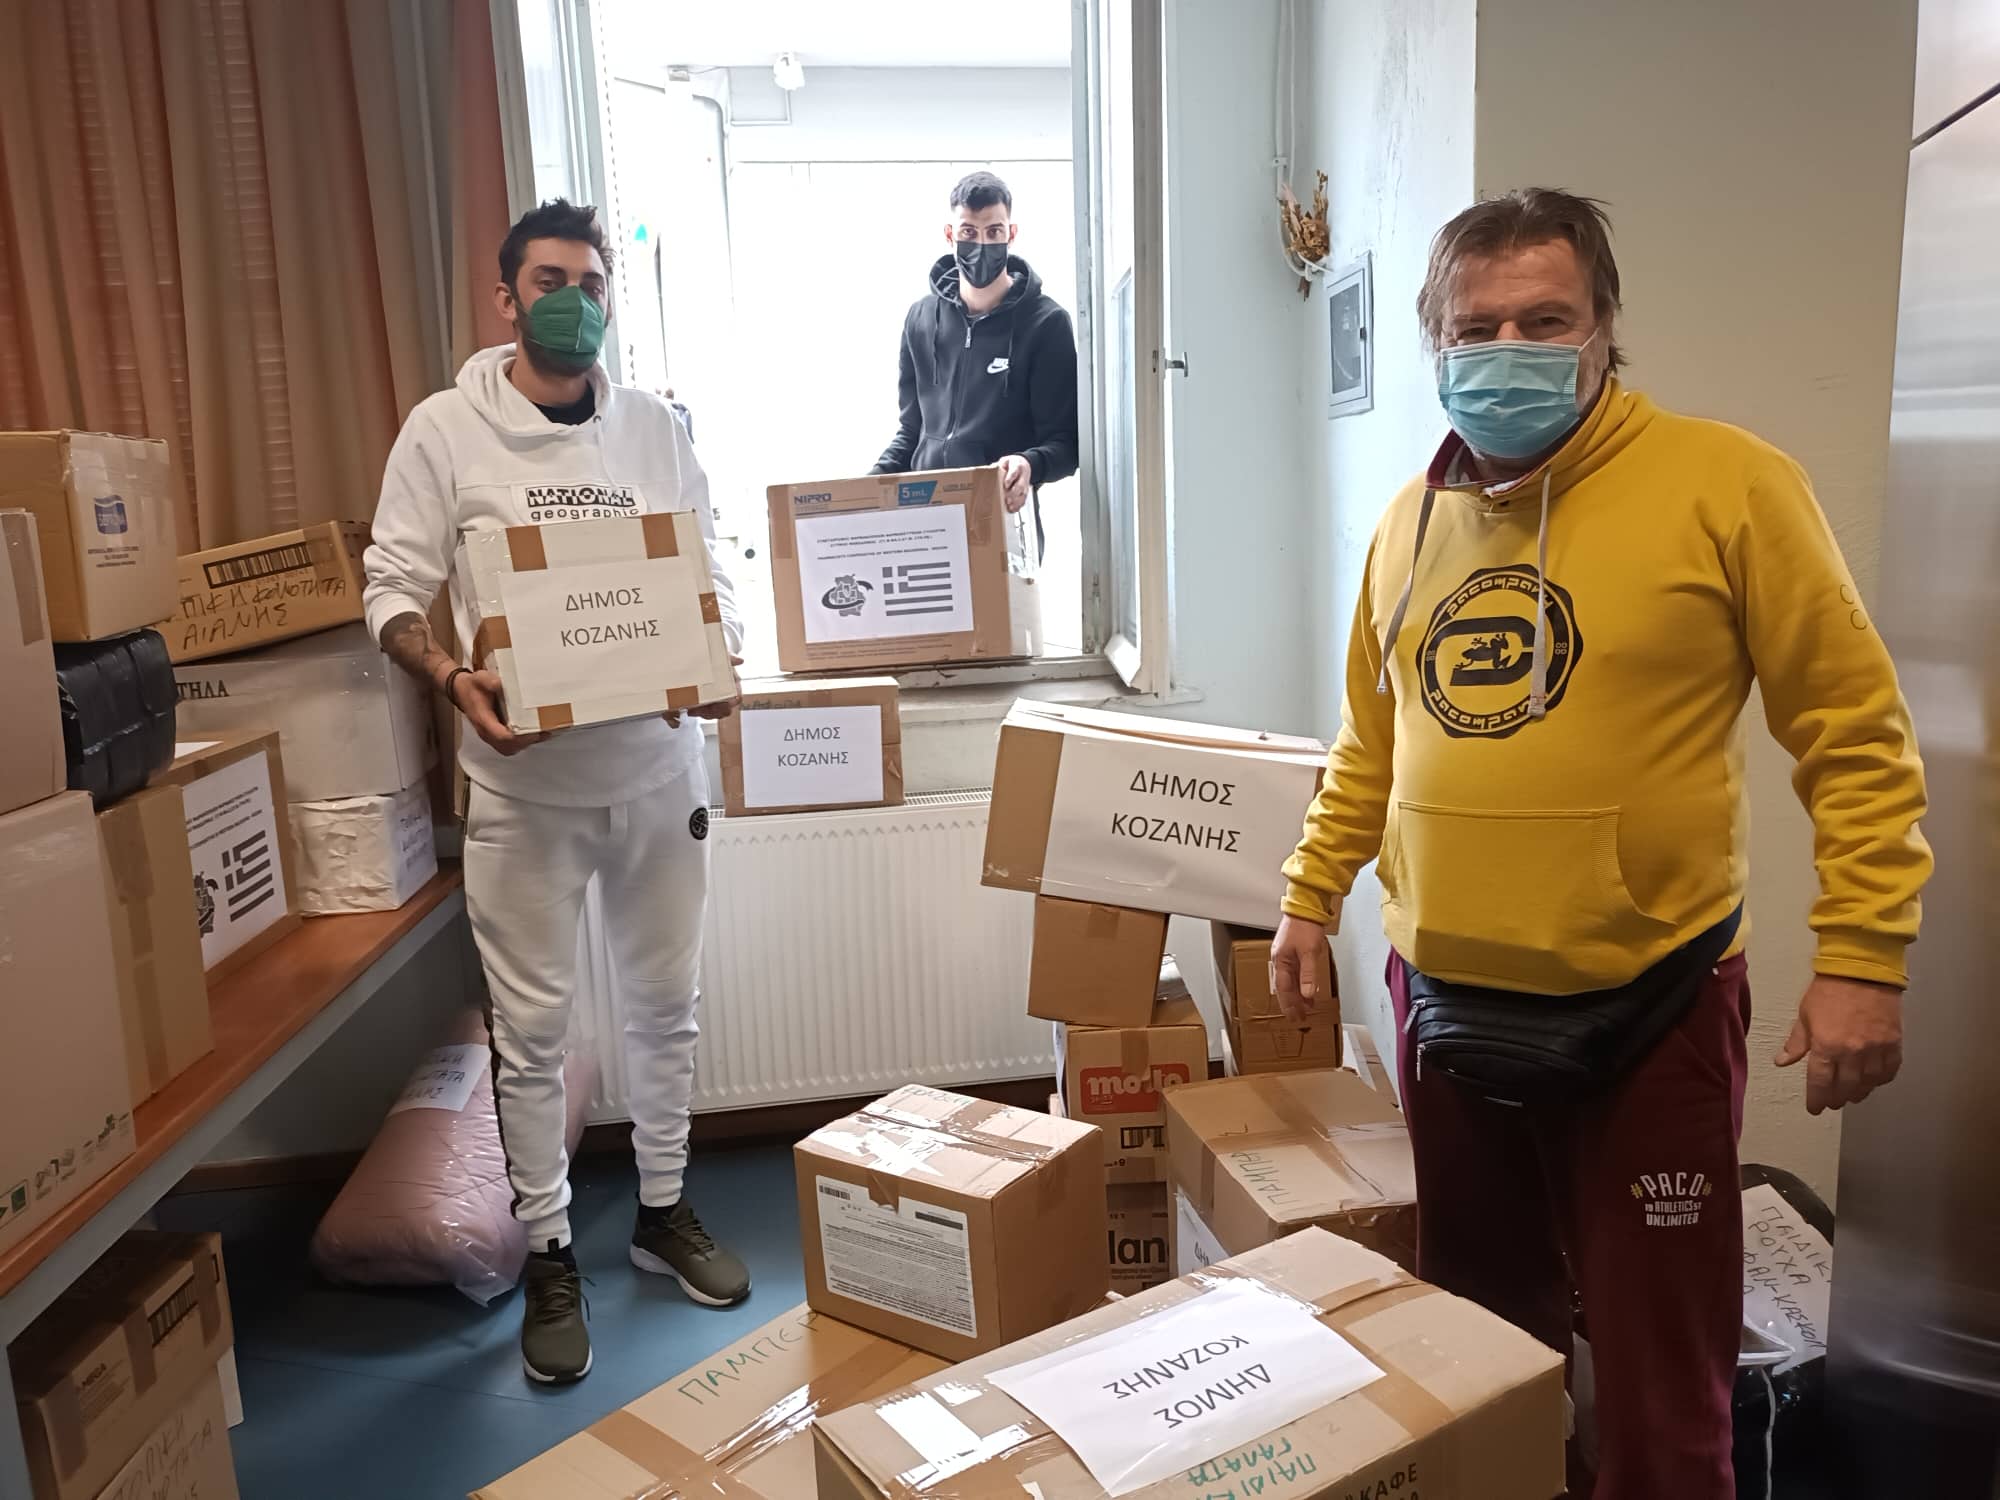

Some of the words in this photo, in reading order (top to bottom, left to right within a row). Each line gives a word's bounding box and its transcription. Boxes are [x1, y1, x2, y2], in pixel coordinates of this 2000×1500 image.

[527, 487, 635, 507] NATIONAL
[794, 492, 832, 505] NIPRO
[902, 487, 911, 499] 5
[530, 508, 639, 521] geographic
[565, 587, 644, 612] ΔΗΜΟΣ
[560, 619, 661, 647] ΚΟΖΑΝΗΣ
[783, 726, 841, 742] ΔΗΜΟΣ
[777, 751, 849, 767] ΚΟΖΑΝΗΣ
[1130, 769, 1236, 806] ΔΗΜΟΣ
[1111, 812, 1241, 853] ΚΟΖΑΝΗΣ
[1646, 1212, 1699, 1227] UNLIMITED
[1108, 1230, 1169, 1265] lan
[1761, 1206, 1832, 1283] ΠΑΙΔΙΚ
[1102, 1335, 1250, 1399] ΚΟΖΑΝΗΣ
[1153, 1363, 1272, 1429] ΔΗΜΟΣ
